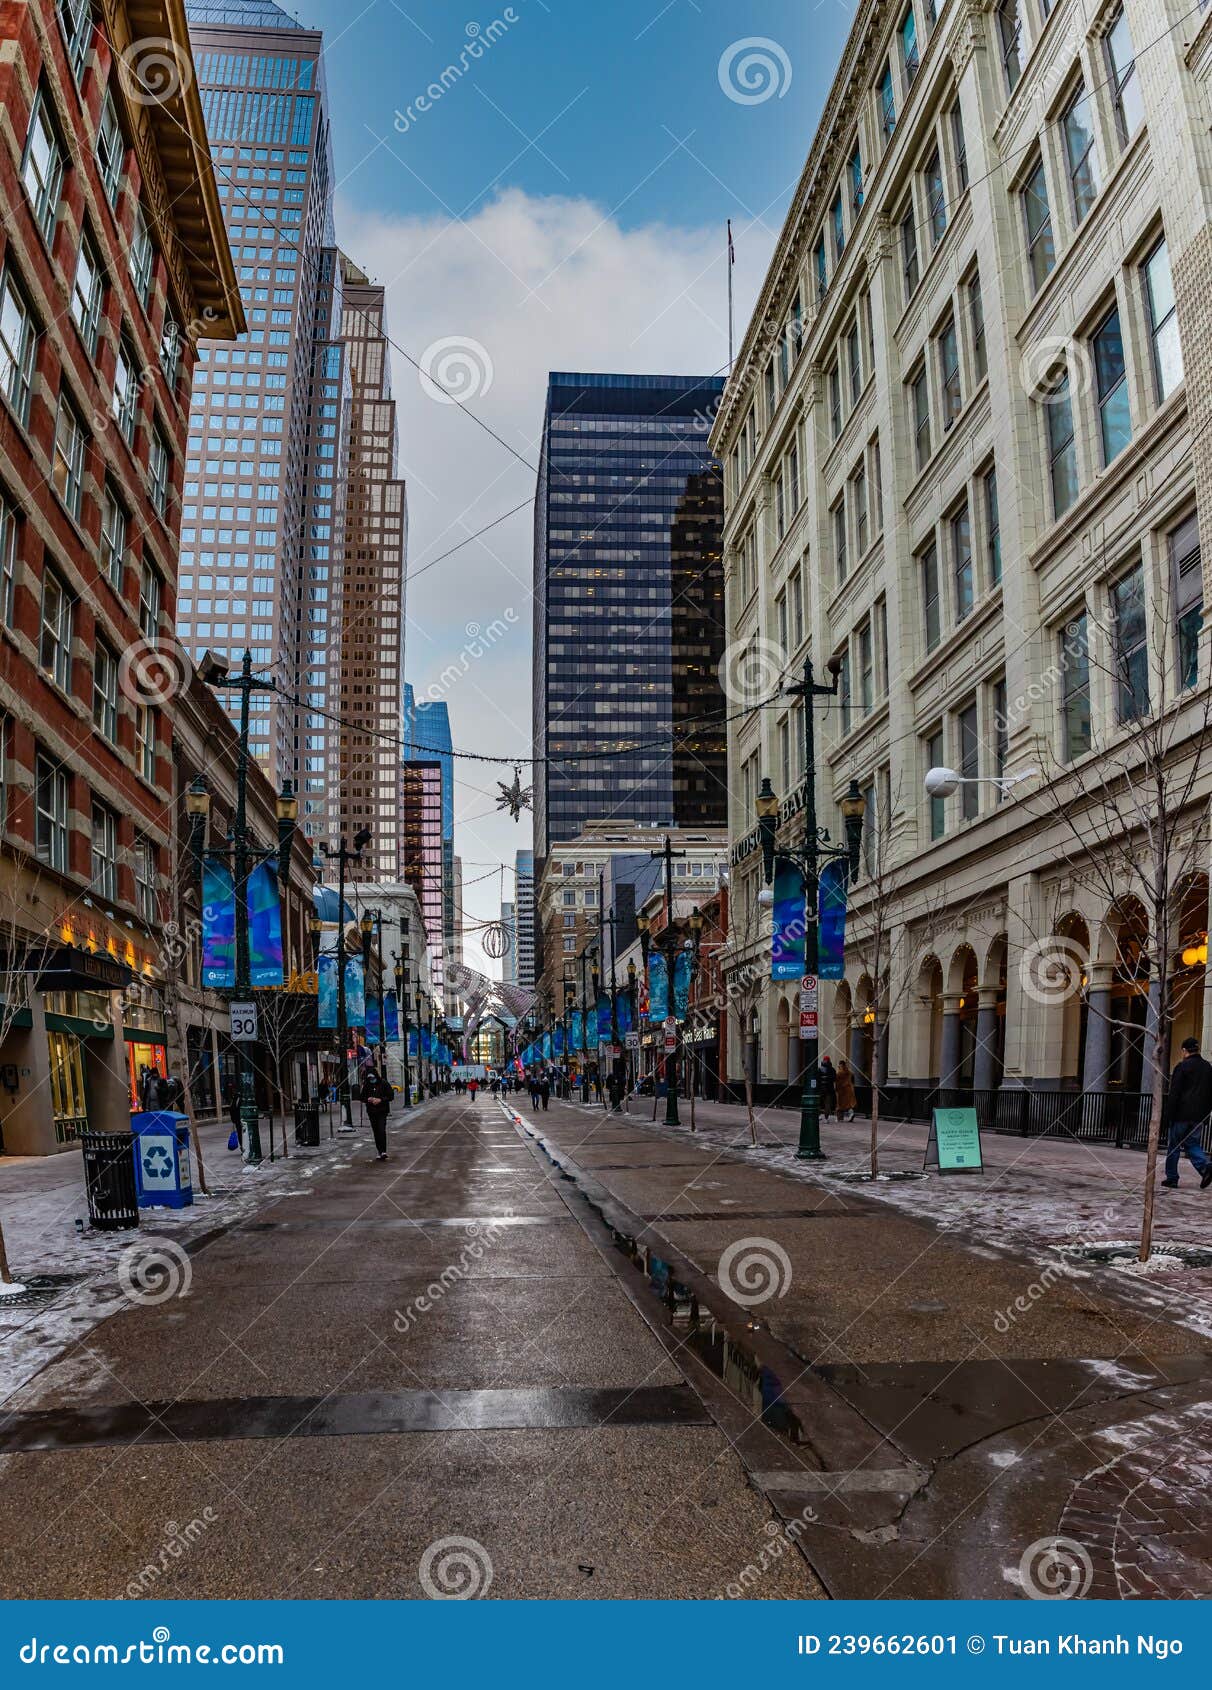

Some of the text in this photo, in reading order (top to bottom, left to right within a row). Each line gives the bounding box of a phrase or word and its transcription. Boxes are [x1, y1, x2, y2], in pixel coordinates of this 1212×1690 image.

[783, 784, 807, 823] BAY
[232, 1019, 255, 1035] 30
[627, 1039, 637, 1047] 30
